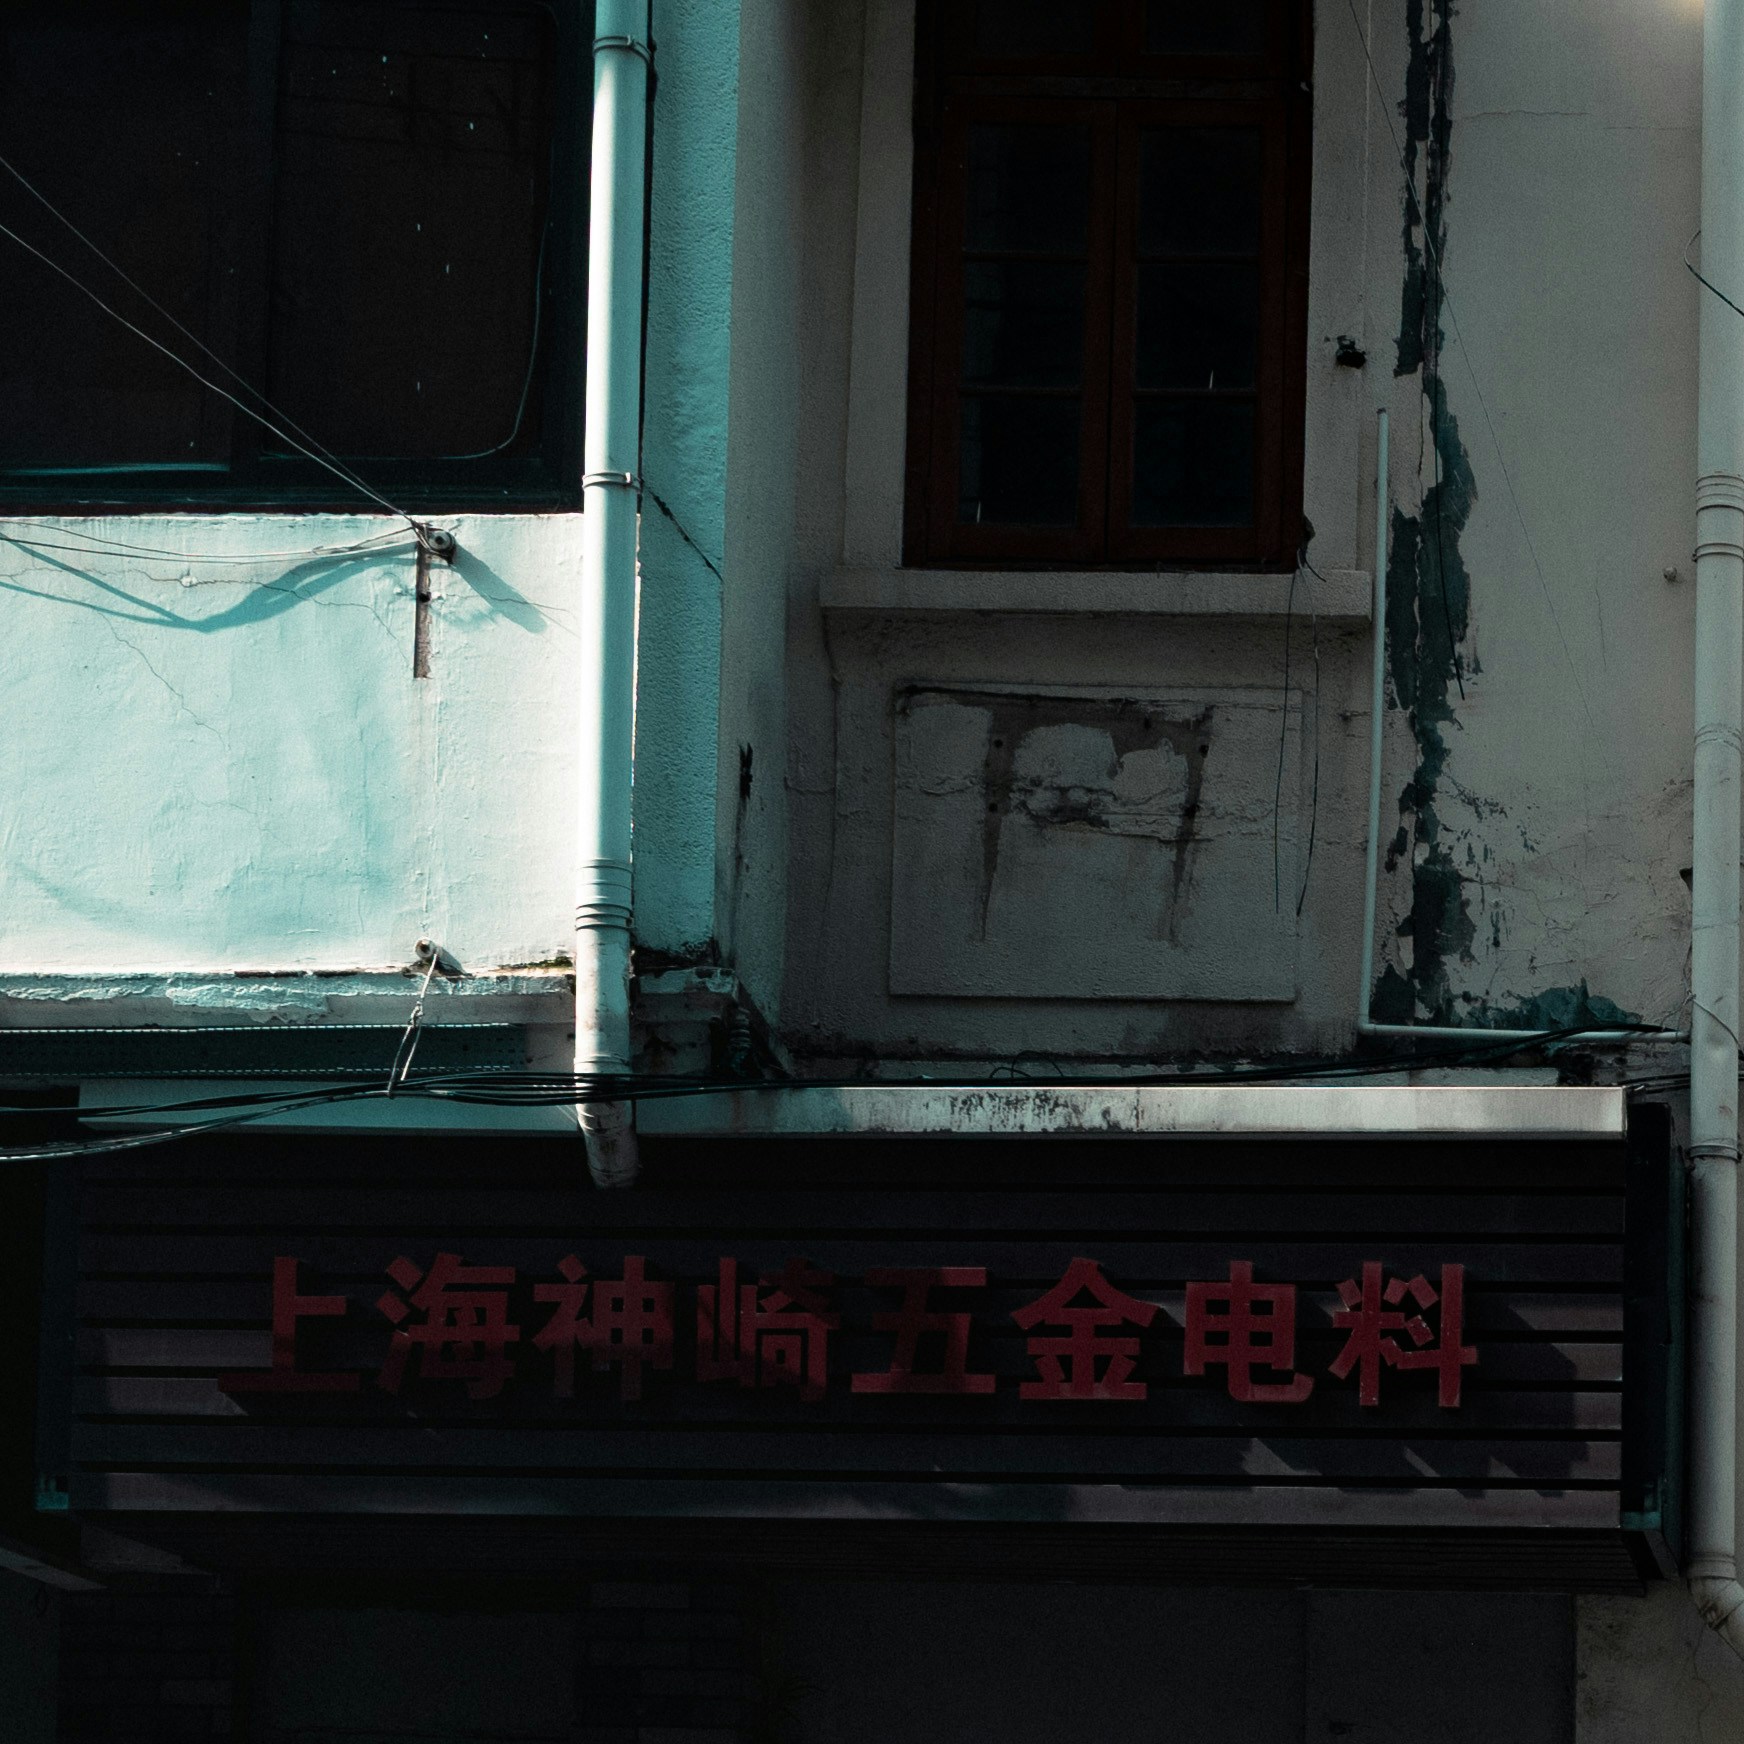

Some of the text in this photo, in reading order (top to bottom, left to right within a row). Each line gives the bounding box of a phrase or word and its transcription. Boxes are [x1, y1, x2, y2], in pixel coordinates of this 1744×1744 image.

[217, 1253, 1478, 1407] 上海神崎五金电料
